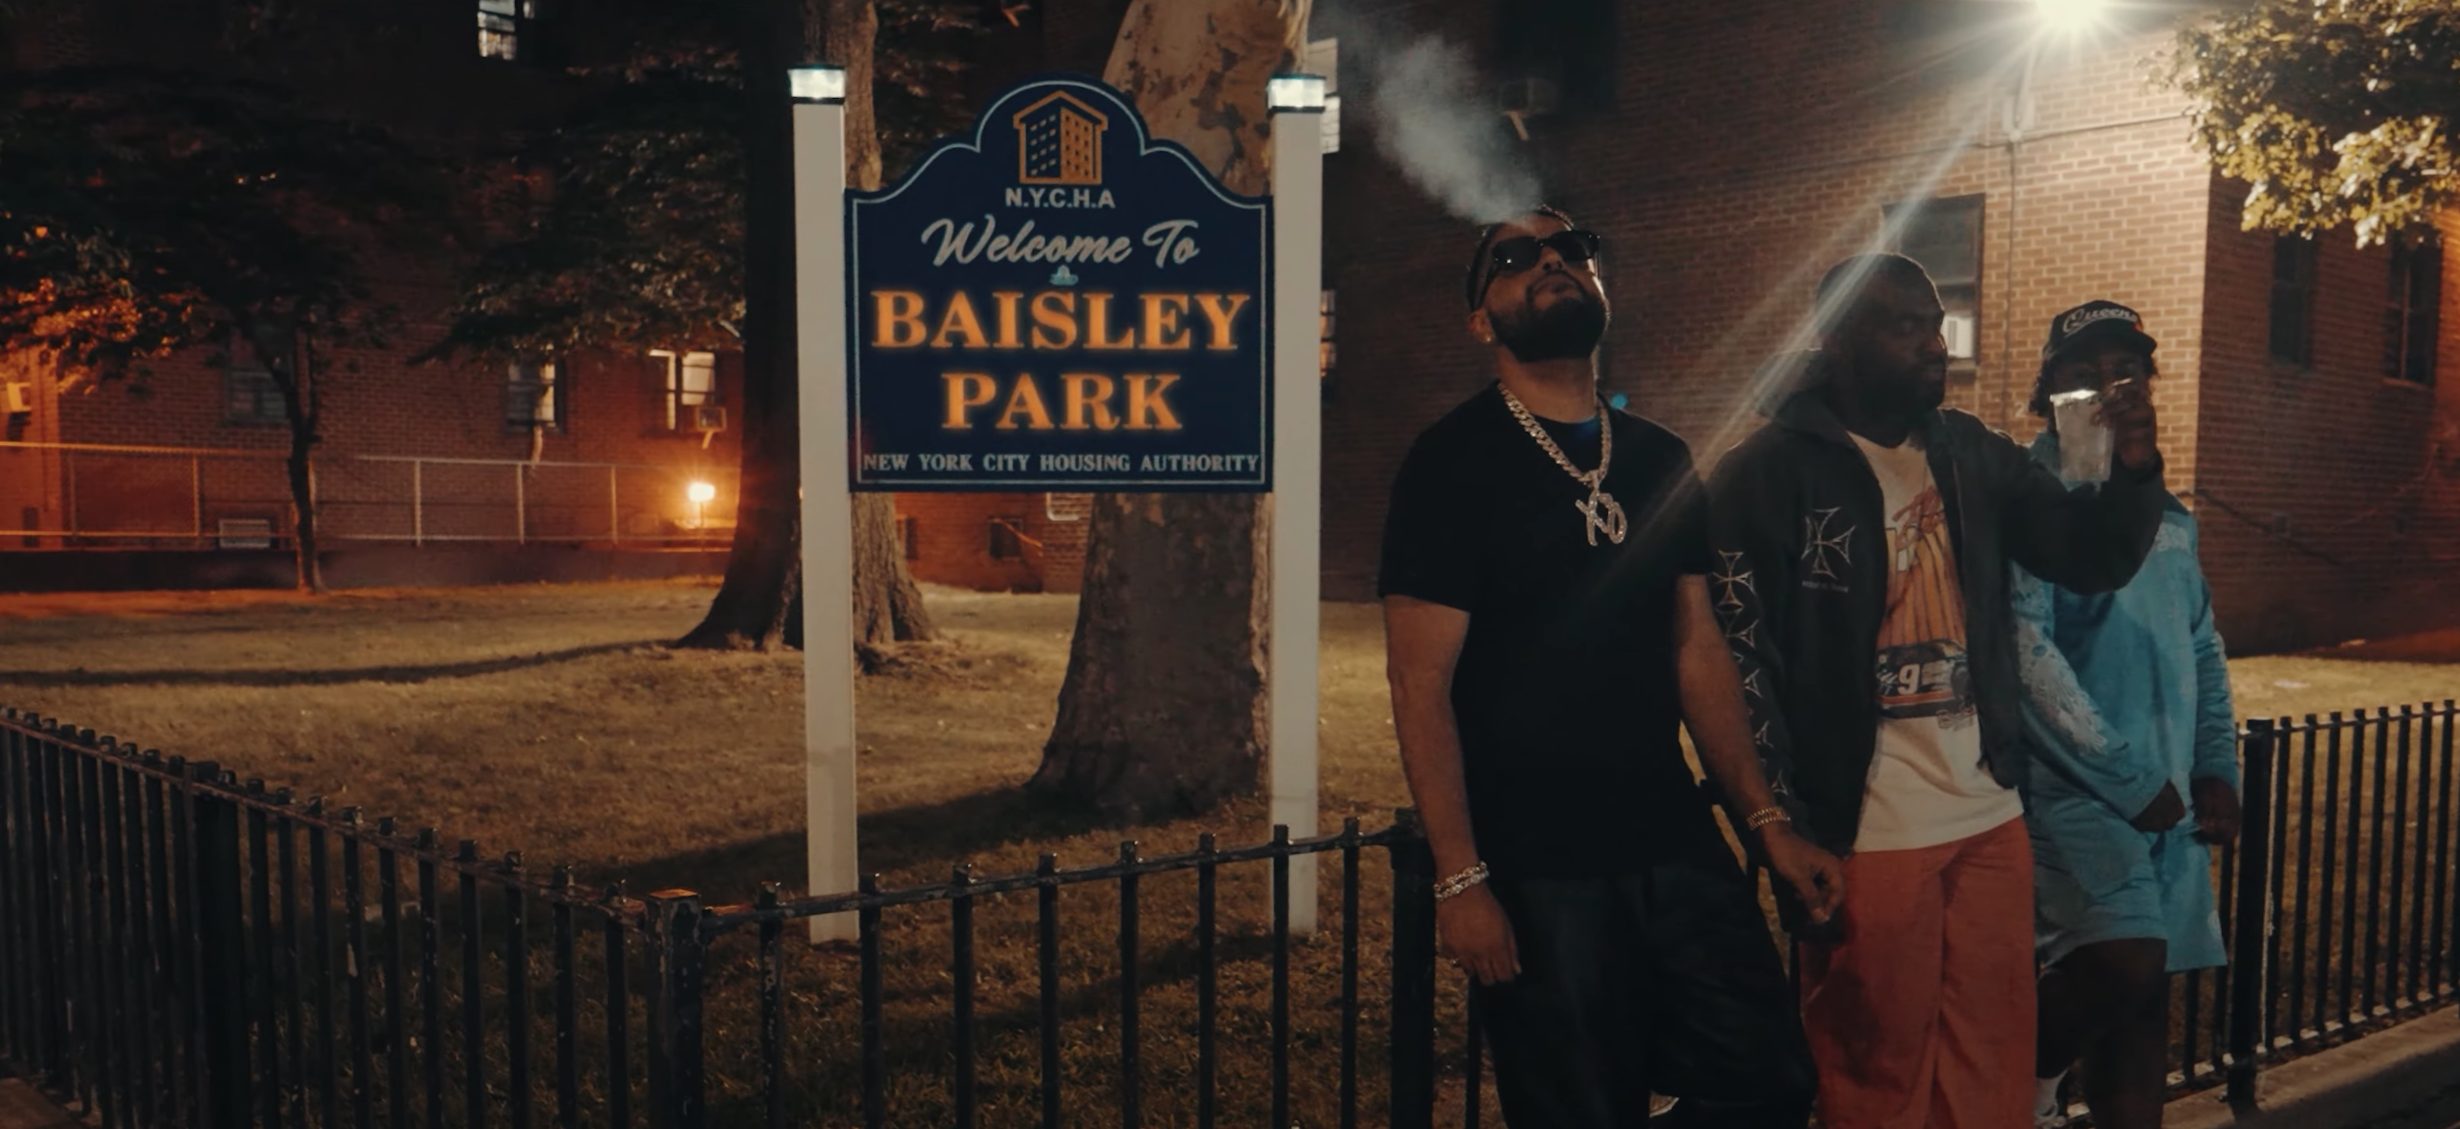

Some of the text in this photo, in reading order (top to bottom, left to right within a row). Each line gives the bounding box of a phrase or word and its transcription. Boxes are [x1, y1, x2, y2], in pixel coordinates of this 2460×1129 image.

[1005, 187, 1116, 209] N.Y.C.H.A
[921, 213, 1201, 268] Welcome To
[870, 290, 1251, 350] BAISLEY
[940, 372, 1183, 430] PARK
[864, 454, 1259, 472] NEW YORK CITY HOUSING AUTHORITY
[1897, 663, 1920, 695] 9
